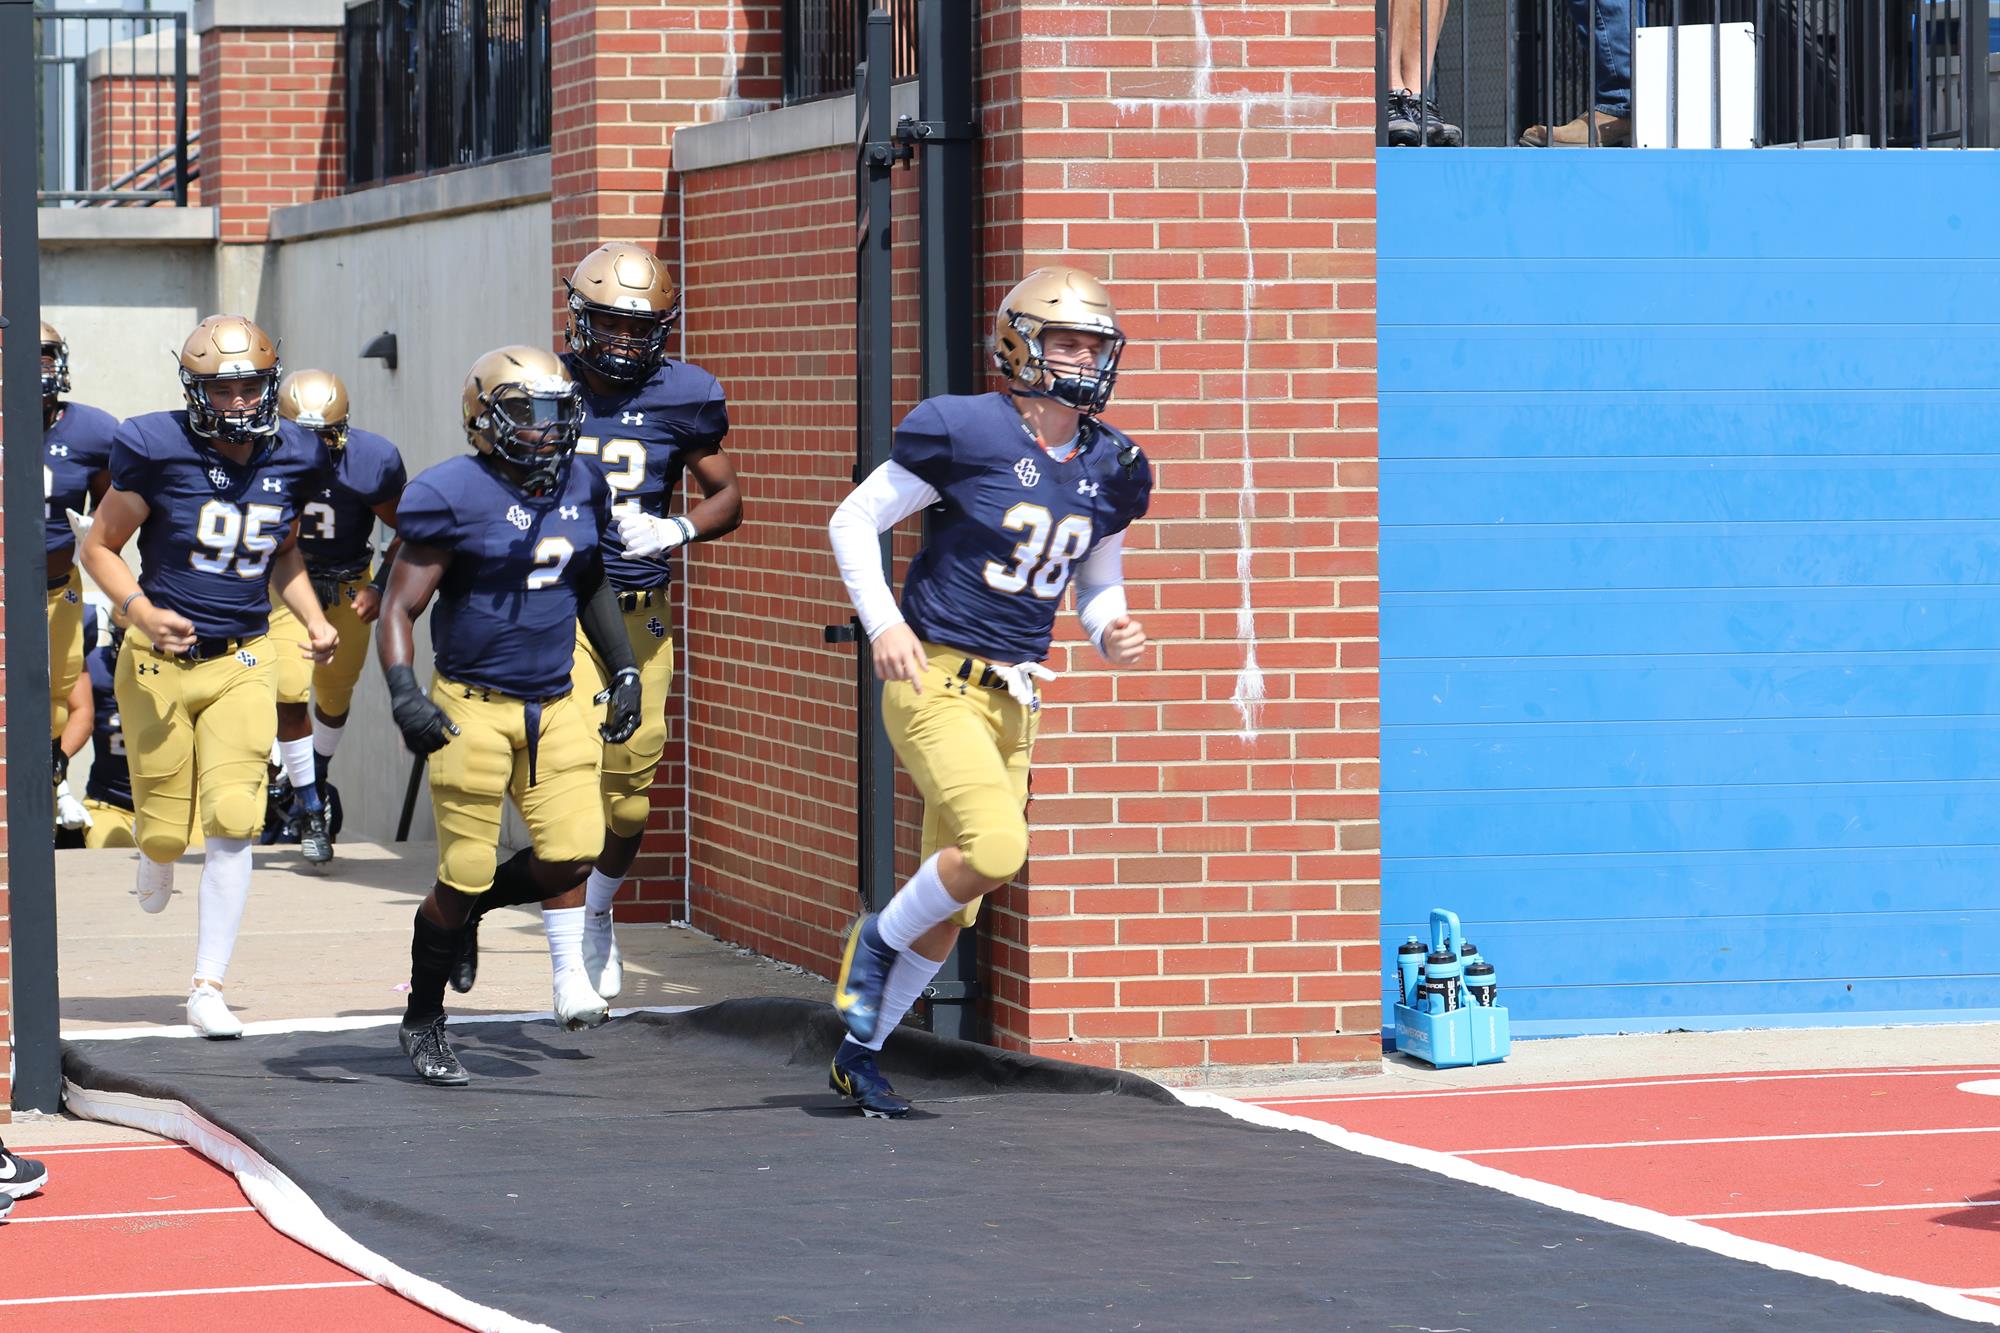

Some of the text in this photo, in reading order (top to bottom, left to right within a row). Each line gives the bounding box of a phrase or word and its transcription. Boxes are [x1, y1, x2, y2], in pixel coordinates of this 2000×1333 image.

[190, 499, 283, 577] 95
[296, 501, 335, 539] 3
[983, 502, 1092, 600] 38
[526, 536, 574, 590] 2
